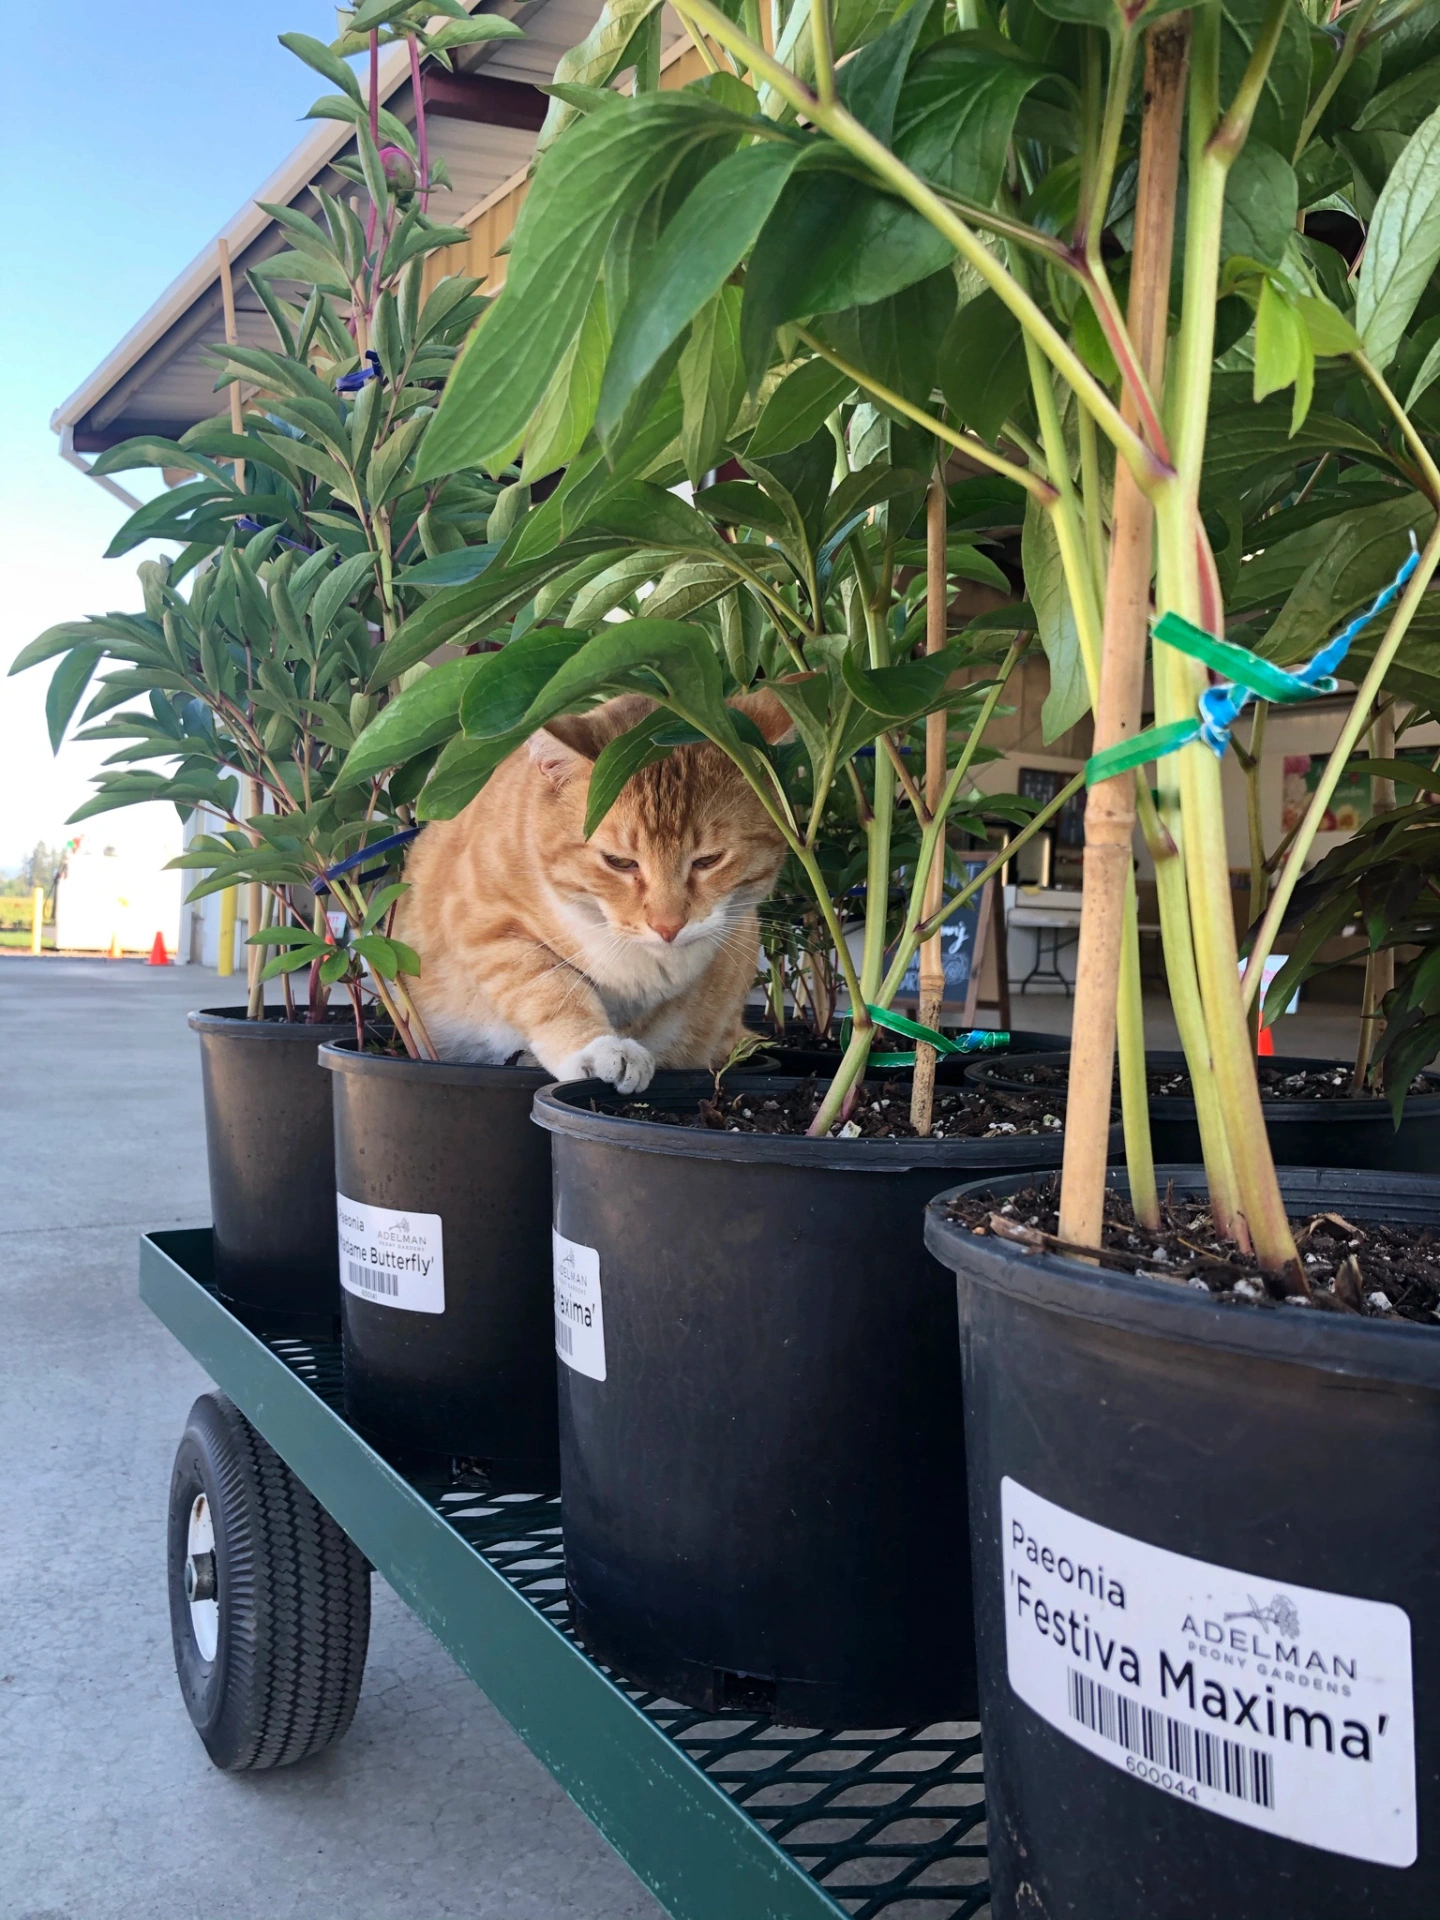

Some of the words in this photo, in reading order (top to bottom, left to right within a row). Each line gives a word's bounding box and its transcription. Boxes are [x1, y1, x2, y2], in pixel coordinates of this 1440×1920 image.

[370, 1246, 435, 1277] Butterfly'
[377, 1230, 427, 1245] ADELMAN
[1011, 1519, 1127, 1610] Paeonia
[1010, 1569, 1142, 1688] 'Festiva
[1158, 1650, 1391, 1764] Maxima'
[1181, 1613, 1358, 1681] ADELMAN
[1187, 1640, 1248, 1670] PEONY
[1256, 1663, 1352, 1698] GARDENS
[1124, 1754, 1200, 1802] 600044
